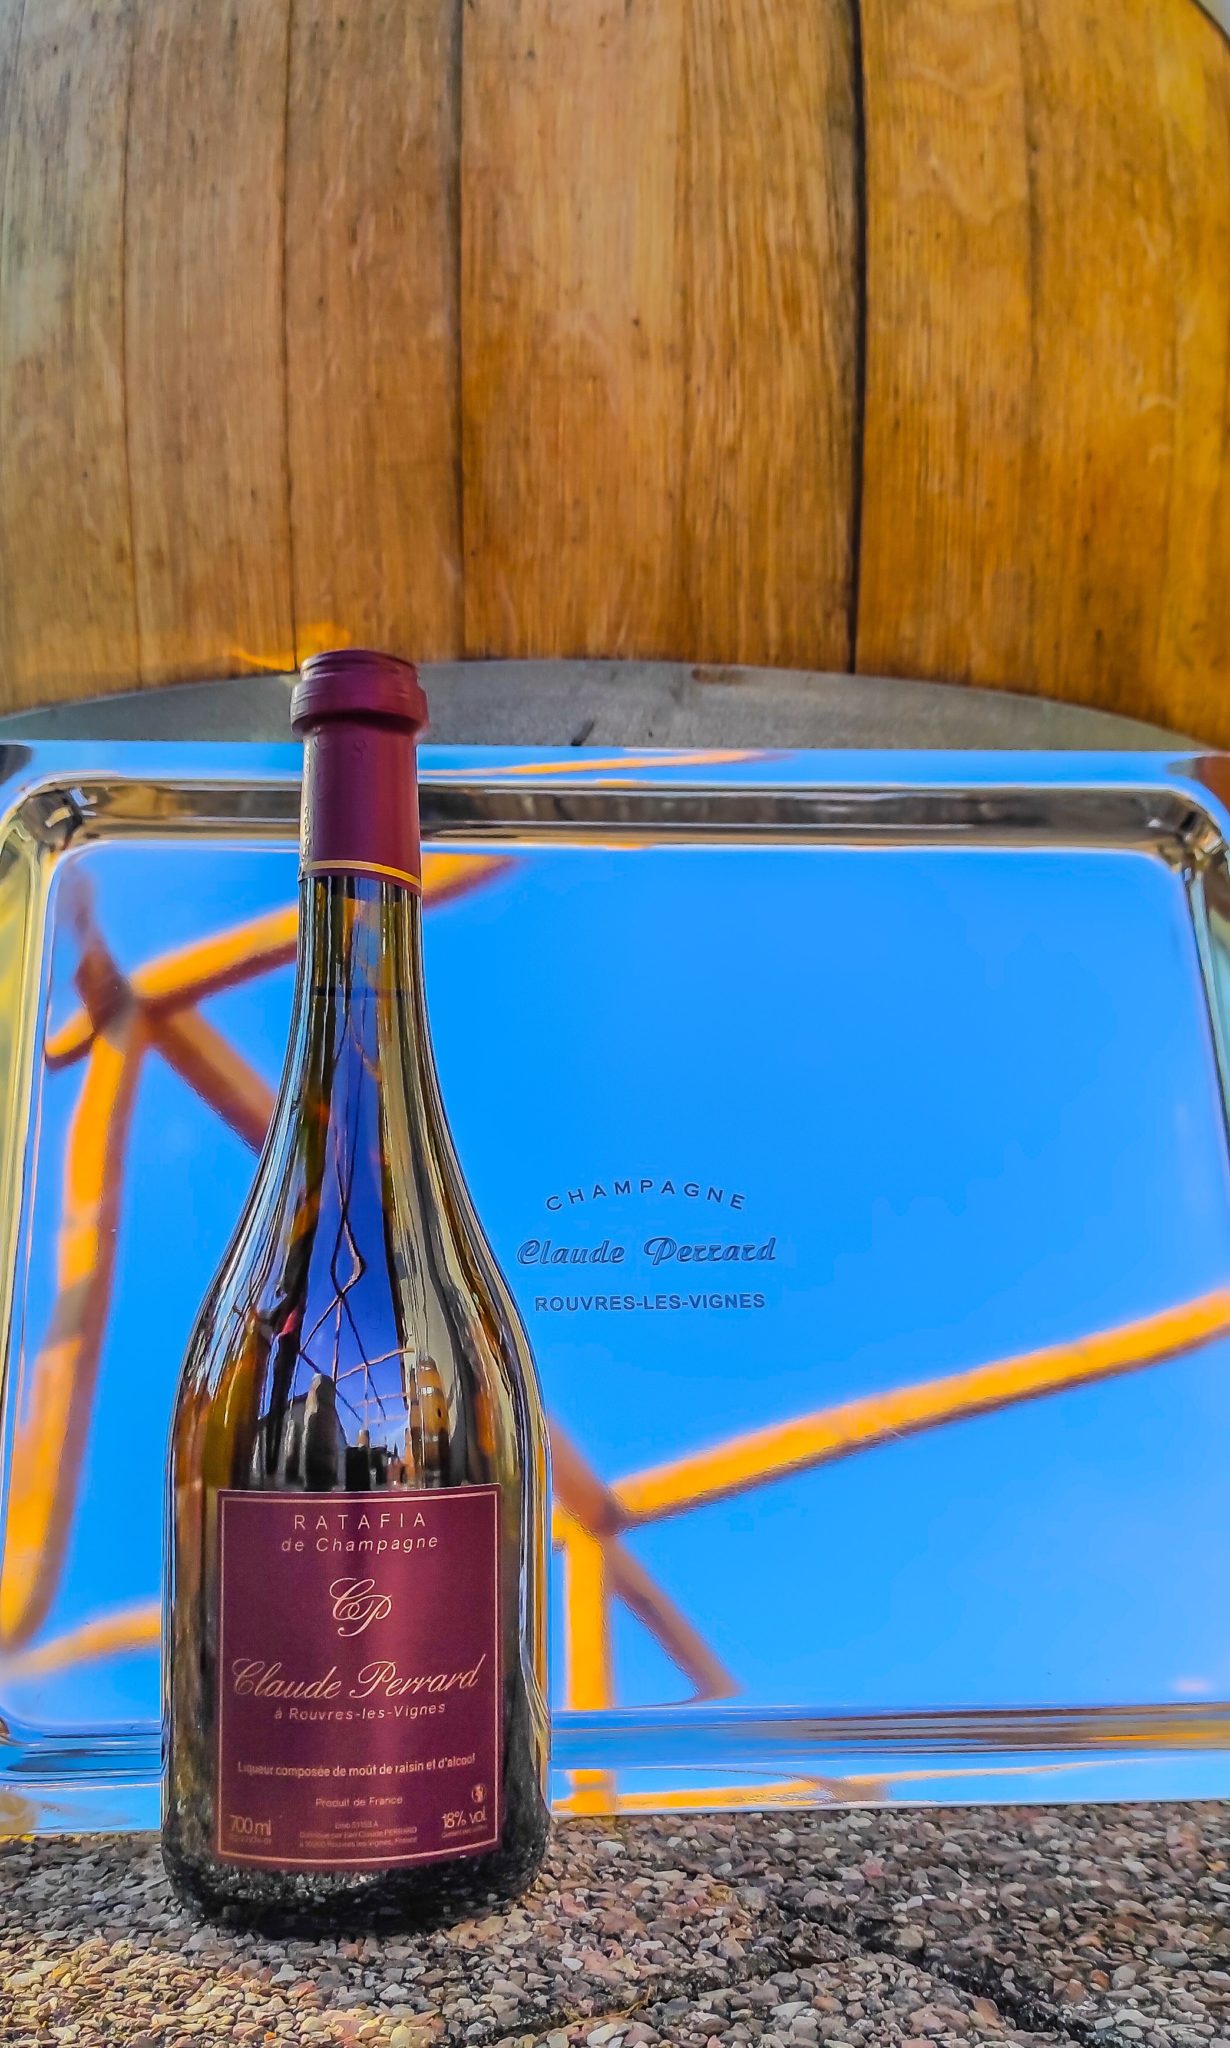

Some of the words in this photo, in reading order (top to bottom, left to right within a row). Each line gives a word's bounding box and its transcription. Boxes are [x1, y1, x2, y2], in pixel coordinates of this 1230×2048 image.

[546, 1180, 746, 1211] CHAMPAGNE
[517, 1239, 625, 1265] Claude
[643, 1237, 777, 1266] Perrard
[534, 1293, 766, 1312] ROUVRES-LES-VIGNES
[293, 1512, 426, 1530] RATAFIA
[281, 1538, 304, 1552] de
[315, 1536, 439, 1554] Champagne
[232, 1658, 342, 1699] Claude
[349, 1653, 487, 1699] Perrard
[289, 1703, 446, 1720] Rouvres-les-Vignes
[237, 1761, 274, 1776] Liqueur
[275, 1765, 331, 1779] composée
[333, 1765, 347, 1777] de
[348, 1764, 377, 1777] moût
[379, 1763, 393, 1775] de
[395, 1761, 424, 1774] raisin
[426, 1759, 436, 1770] et
[437, 1752, 476, 1769] d'alcool
[315, 1798, 350, 1808] Produit
[353, 1798, 367, 1807] de
[369, 1796, 403, 1806] France
[441, 1810, 467, 1829] 18%
